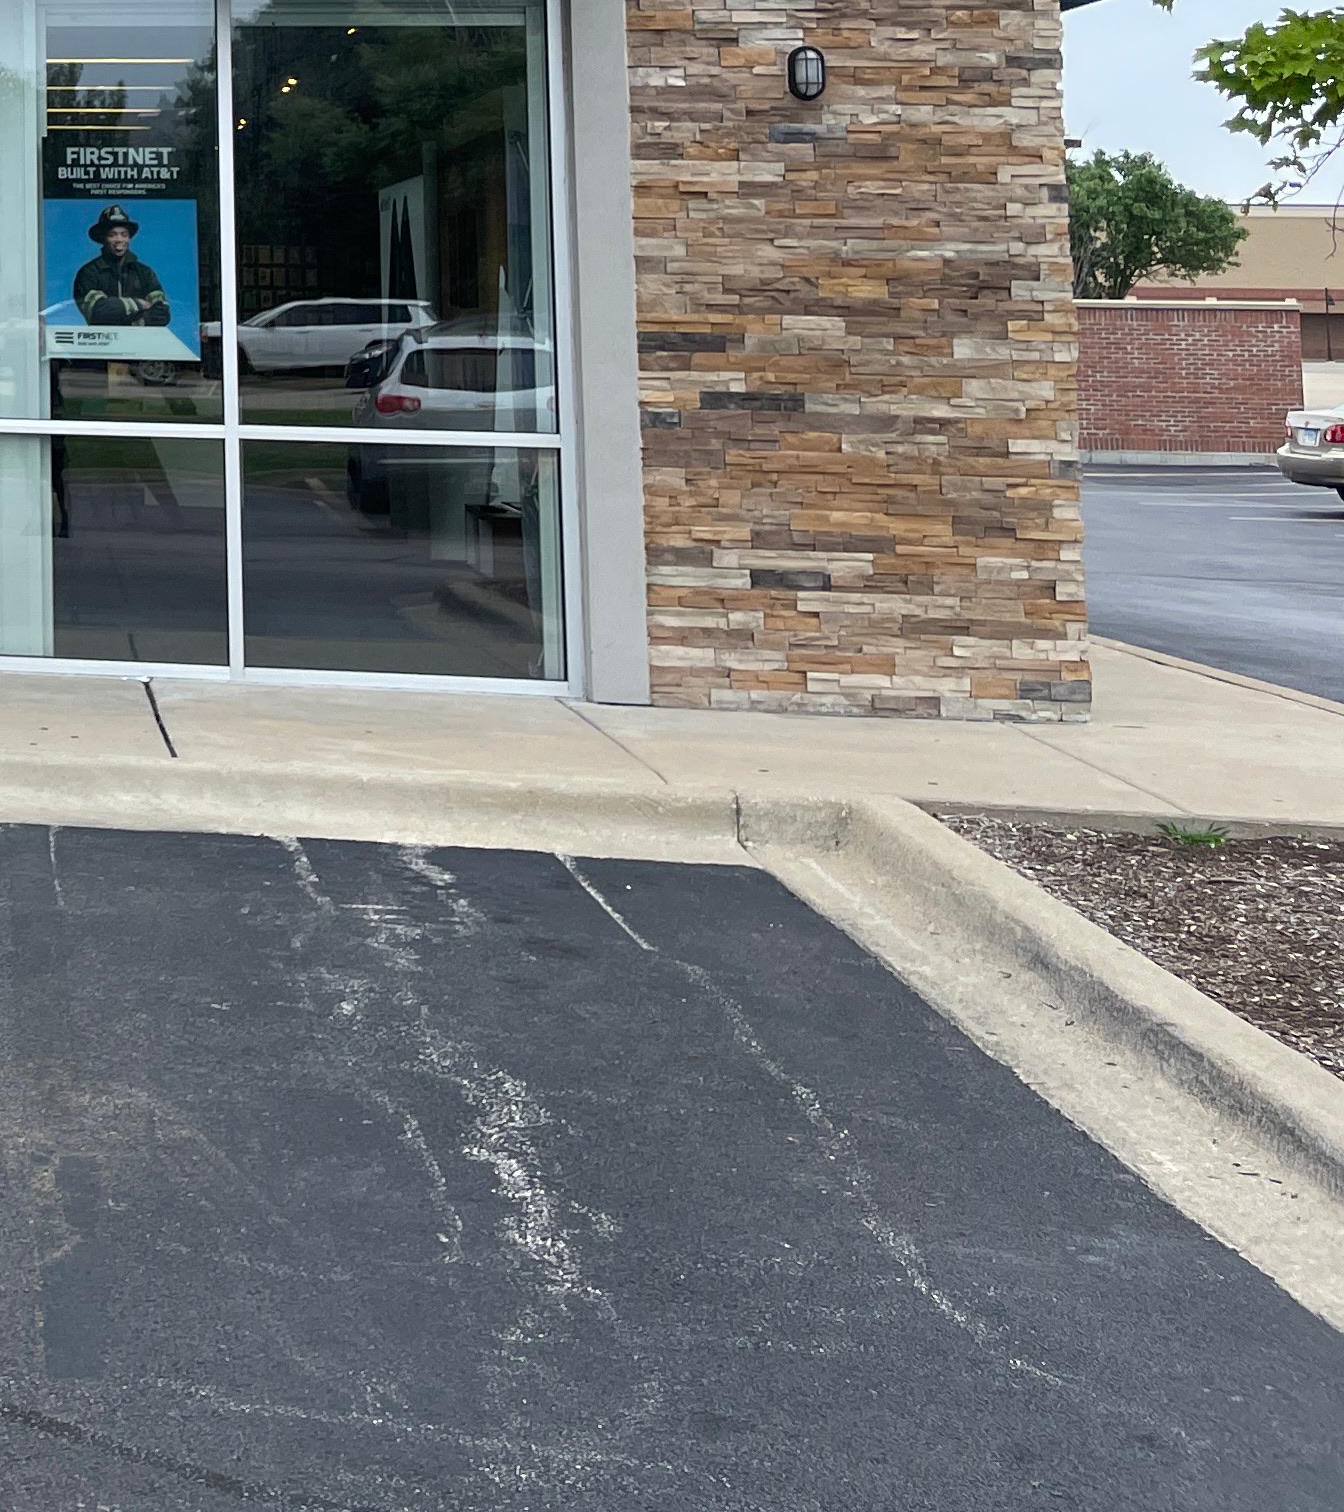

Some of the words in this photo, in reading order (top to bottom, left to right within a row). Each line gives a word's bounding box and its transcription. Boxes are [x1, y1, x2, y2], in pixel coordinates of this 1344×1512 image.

[66, 147, 174, 165] FIRSTNET
[57, 166, 96, 179] BUILT
[99, 166, 138, 179] WITH
[141, 167, 180, 179] AT&T
